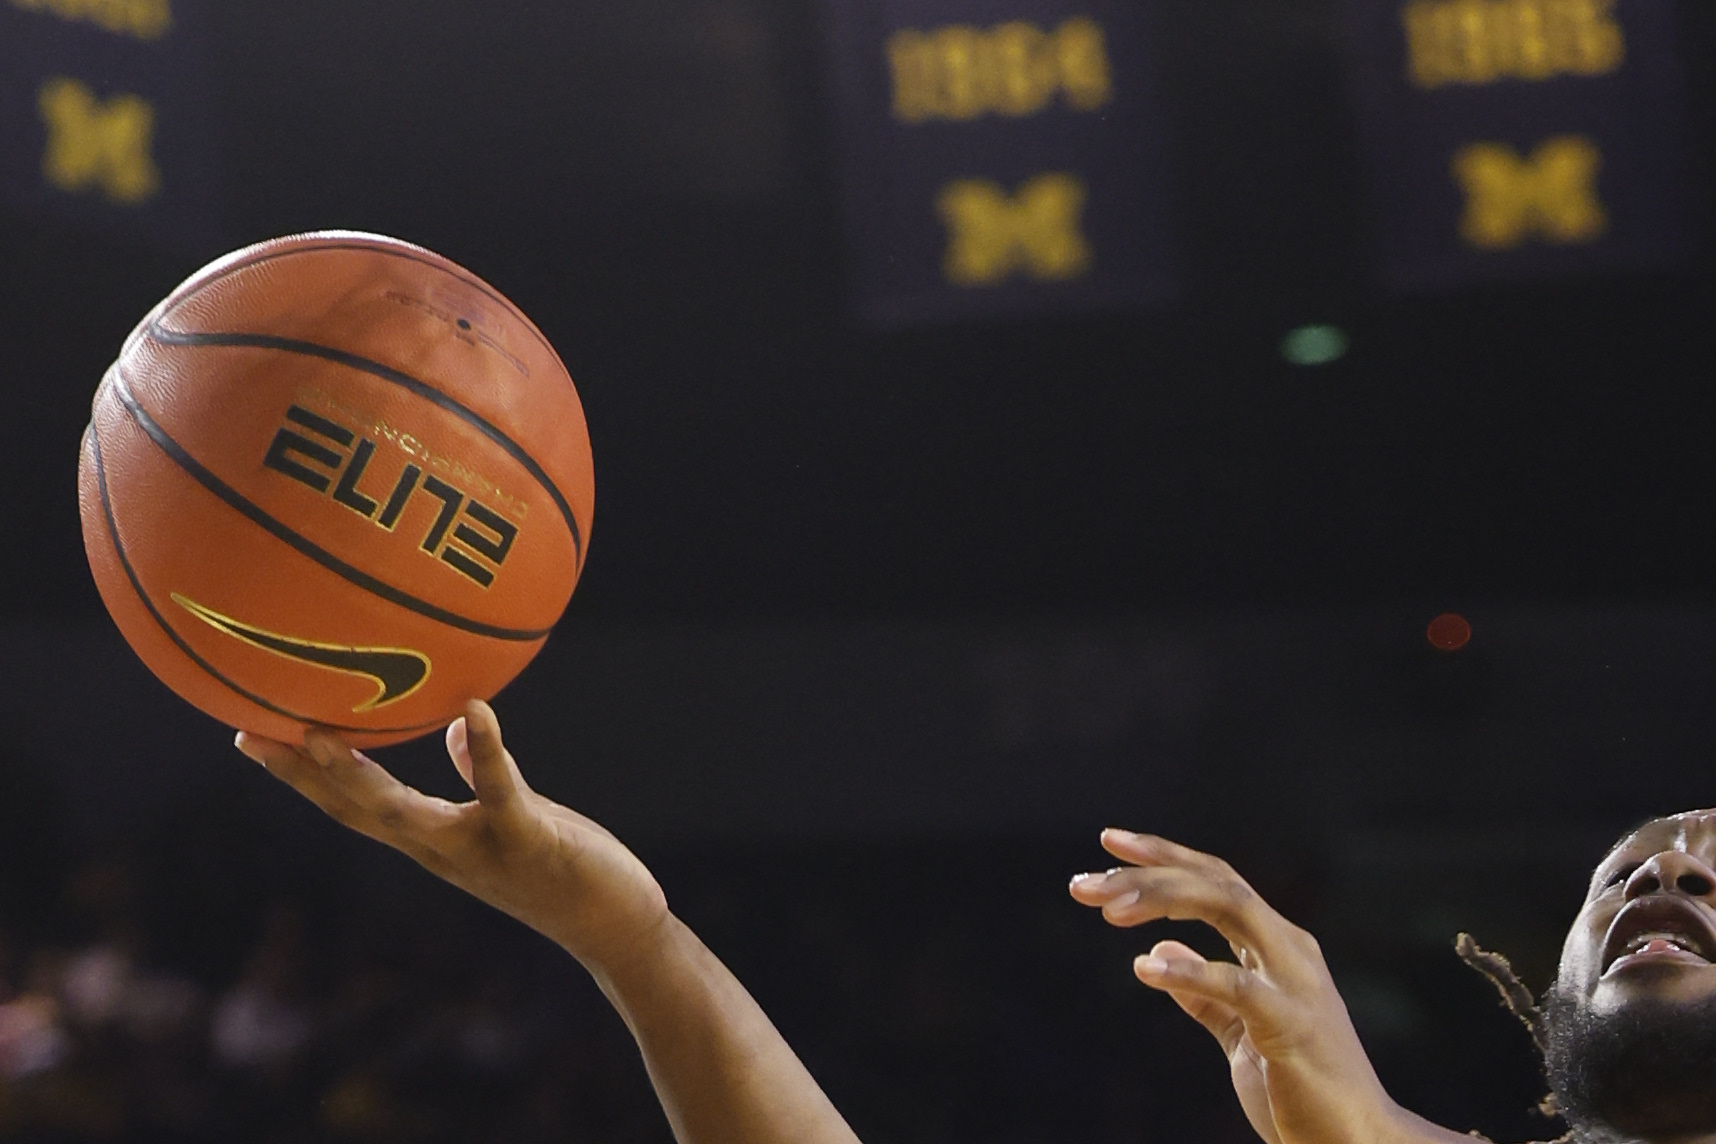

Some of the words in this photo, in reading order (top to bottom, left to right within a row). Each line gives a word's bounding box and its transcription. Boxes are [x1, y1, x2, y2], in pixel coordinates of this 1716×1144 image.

[937, 173, 1089, 285] M
[1452, 135, 1604, 248] M
[263, 403, 519, 589] ELITE
